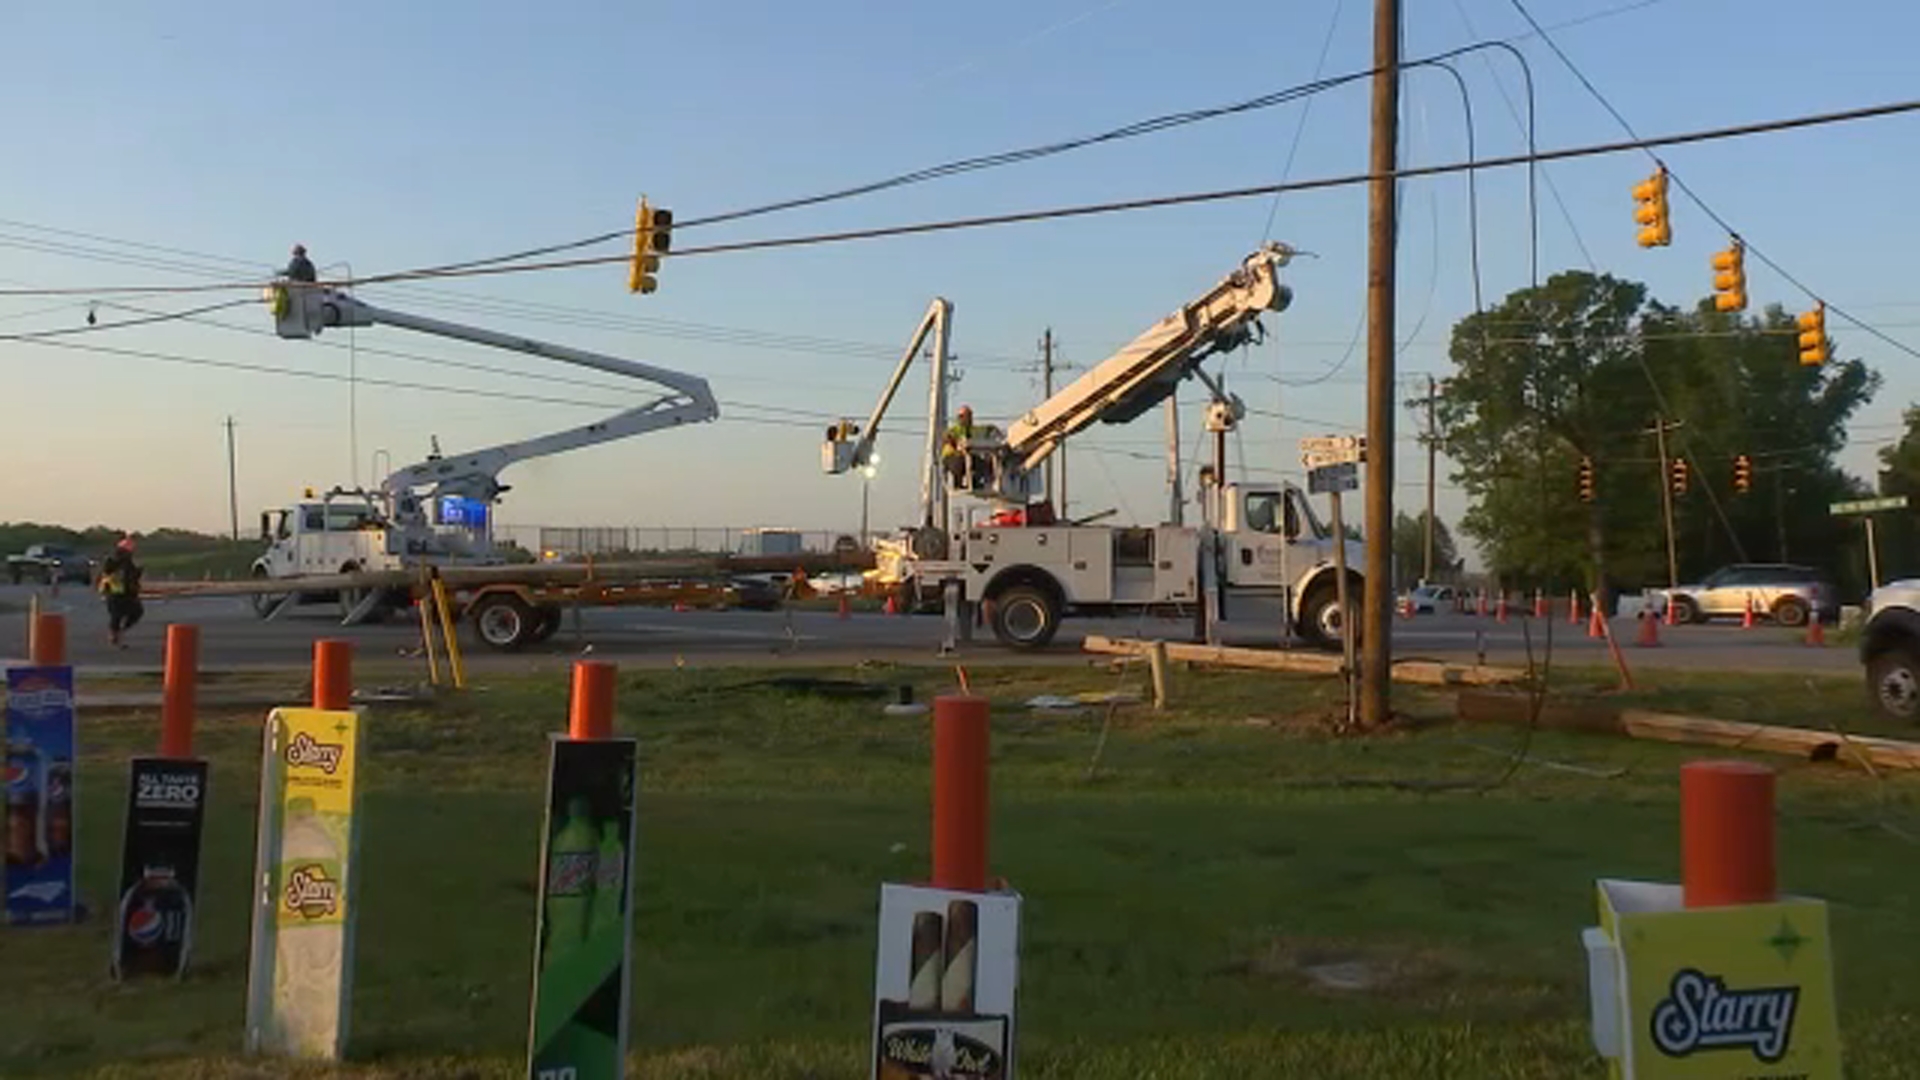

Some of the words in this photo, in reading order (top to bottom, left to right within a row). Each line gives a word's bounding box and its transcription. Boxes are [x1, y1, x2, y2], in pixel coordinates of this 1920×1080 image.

[138, 785, 200, 801] ZERO
[1653, 970, 1797, 1061] Starry
[887, 1036, 932, 1064] White
